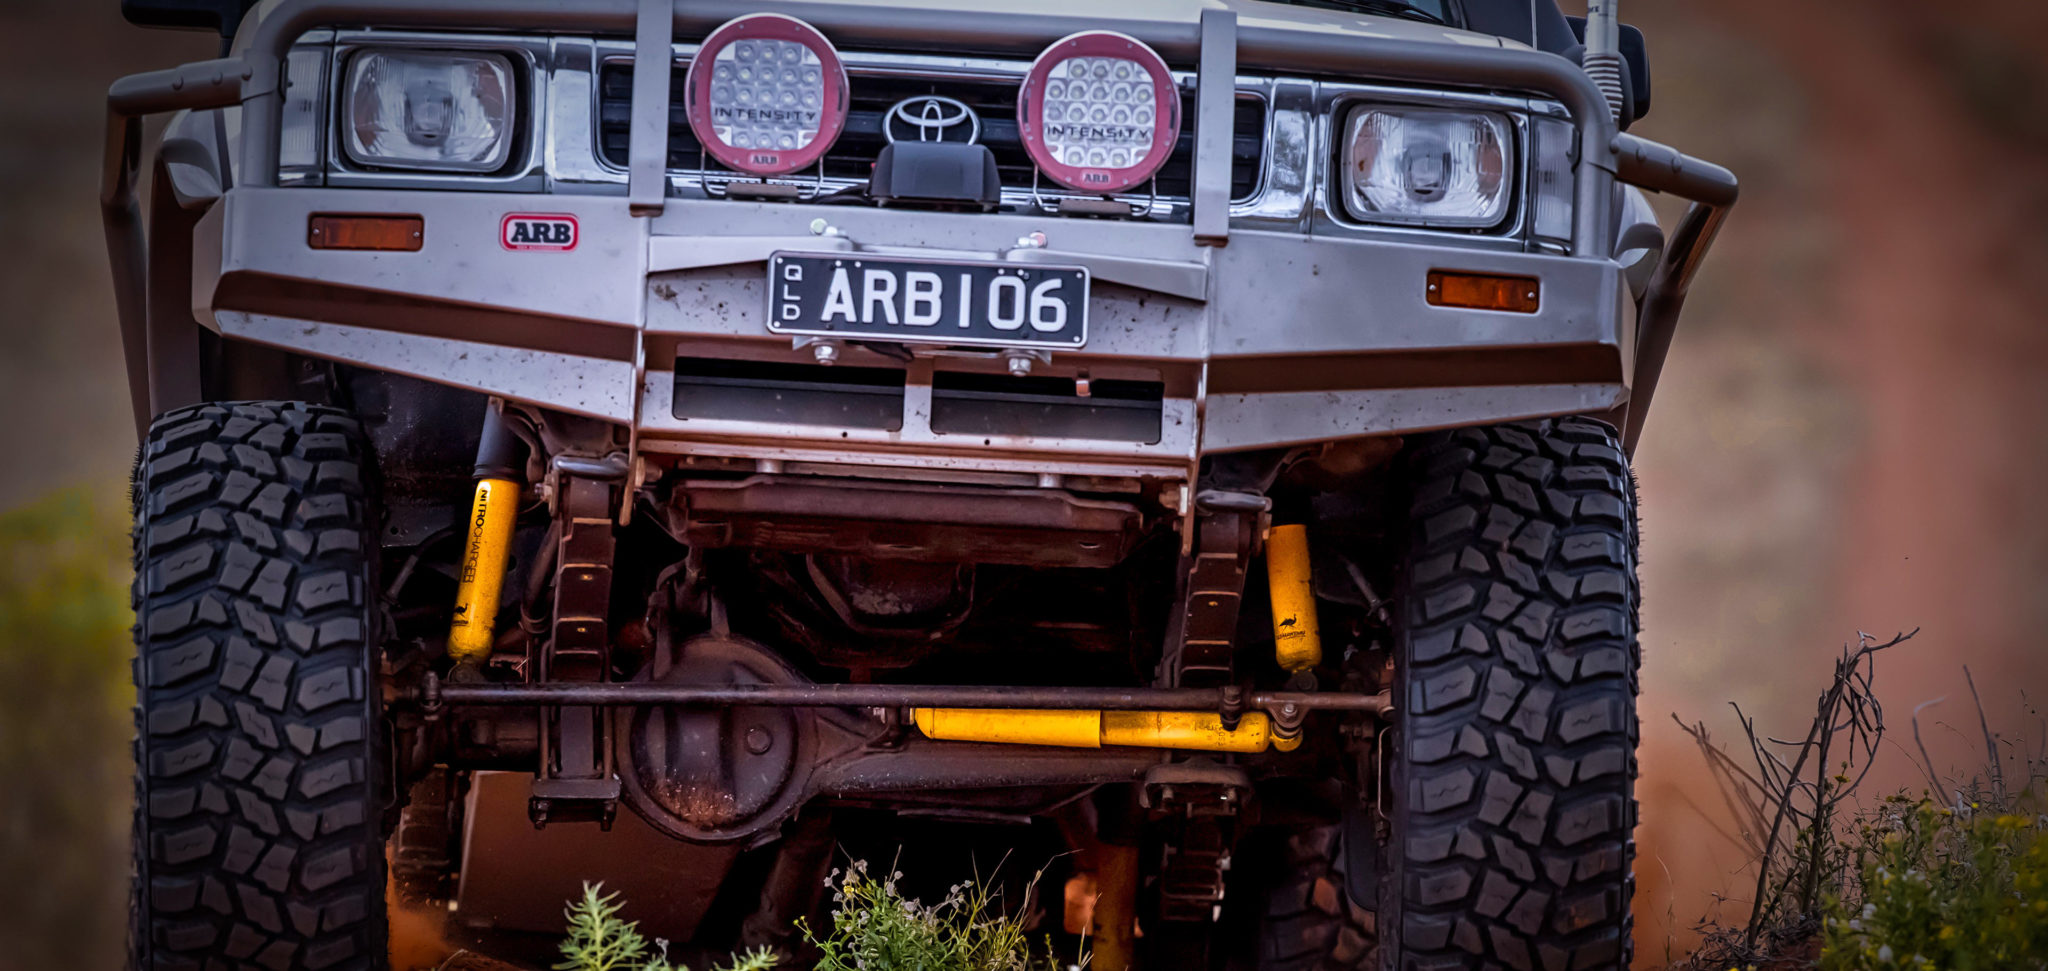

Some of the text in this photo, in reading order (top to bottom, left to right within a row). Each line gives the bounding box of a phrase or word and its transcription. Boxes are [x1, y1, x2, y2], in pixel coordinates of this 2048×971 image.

[714, 107, 817, 121] INTENSITY
[1047, 125, 1149, 139] INTENSITY
[752, 155, 778, 165] ARB
[1084, 173, 1109, 184] ARB
[510, 222, 572, 244] ARB
